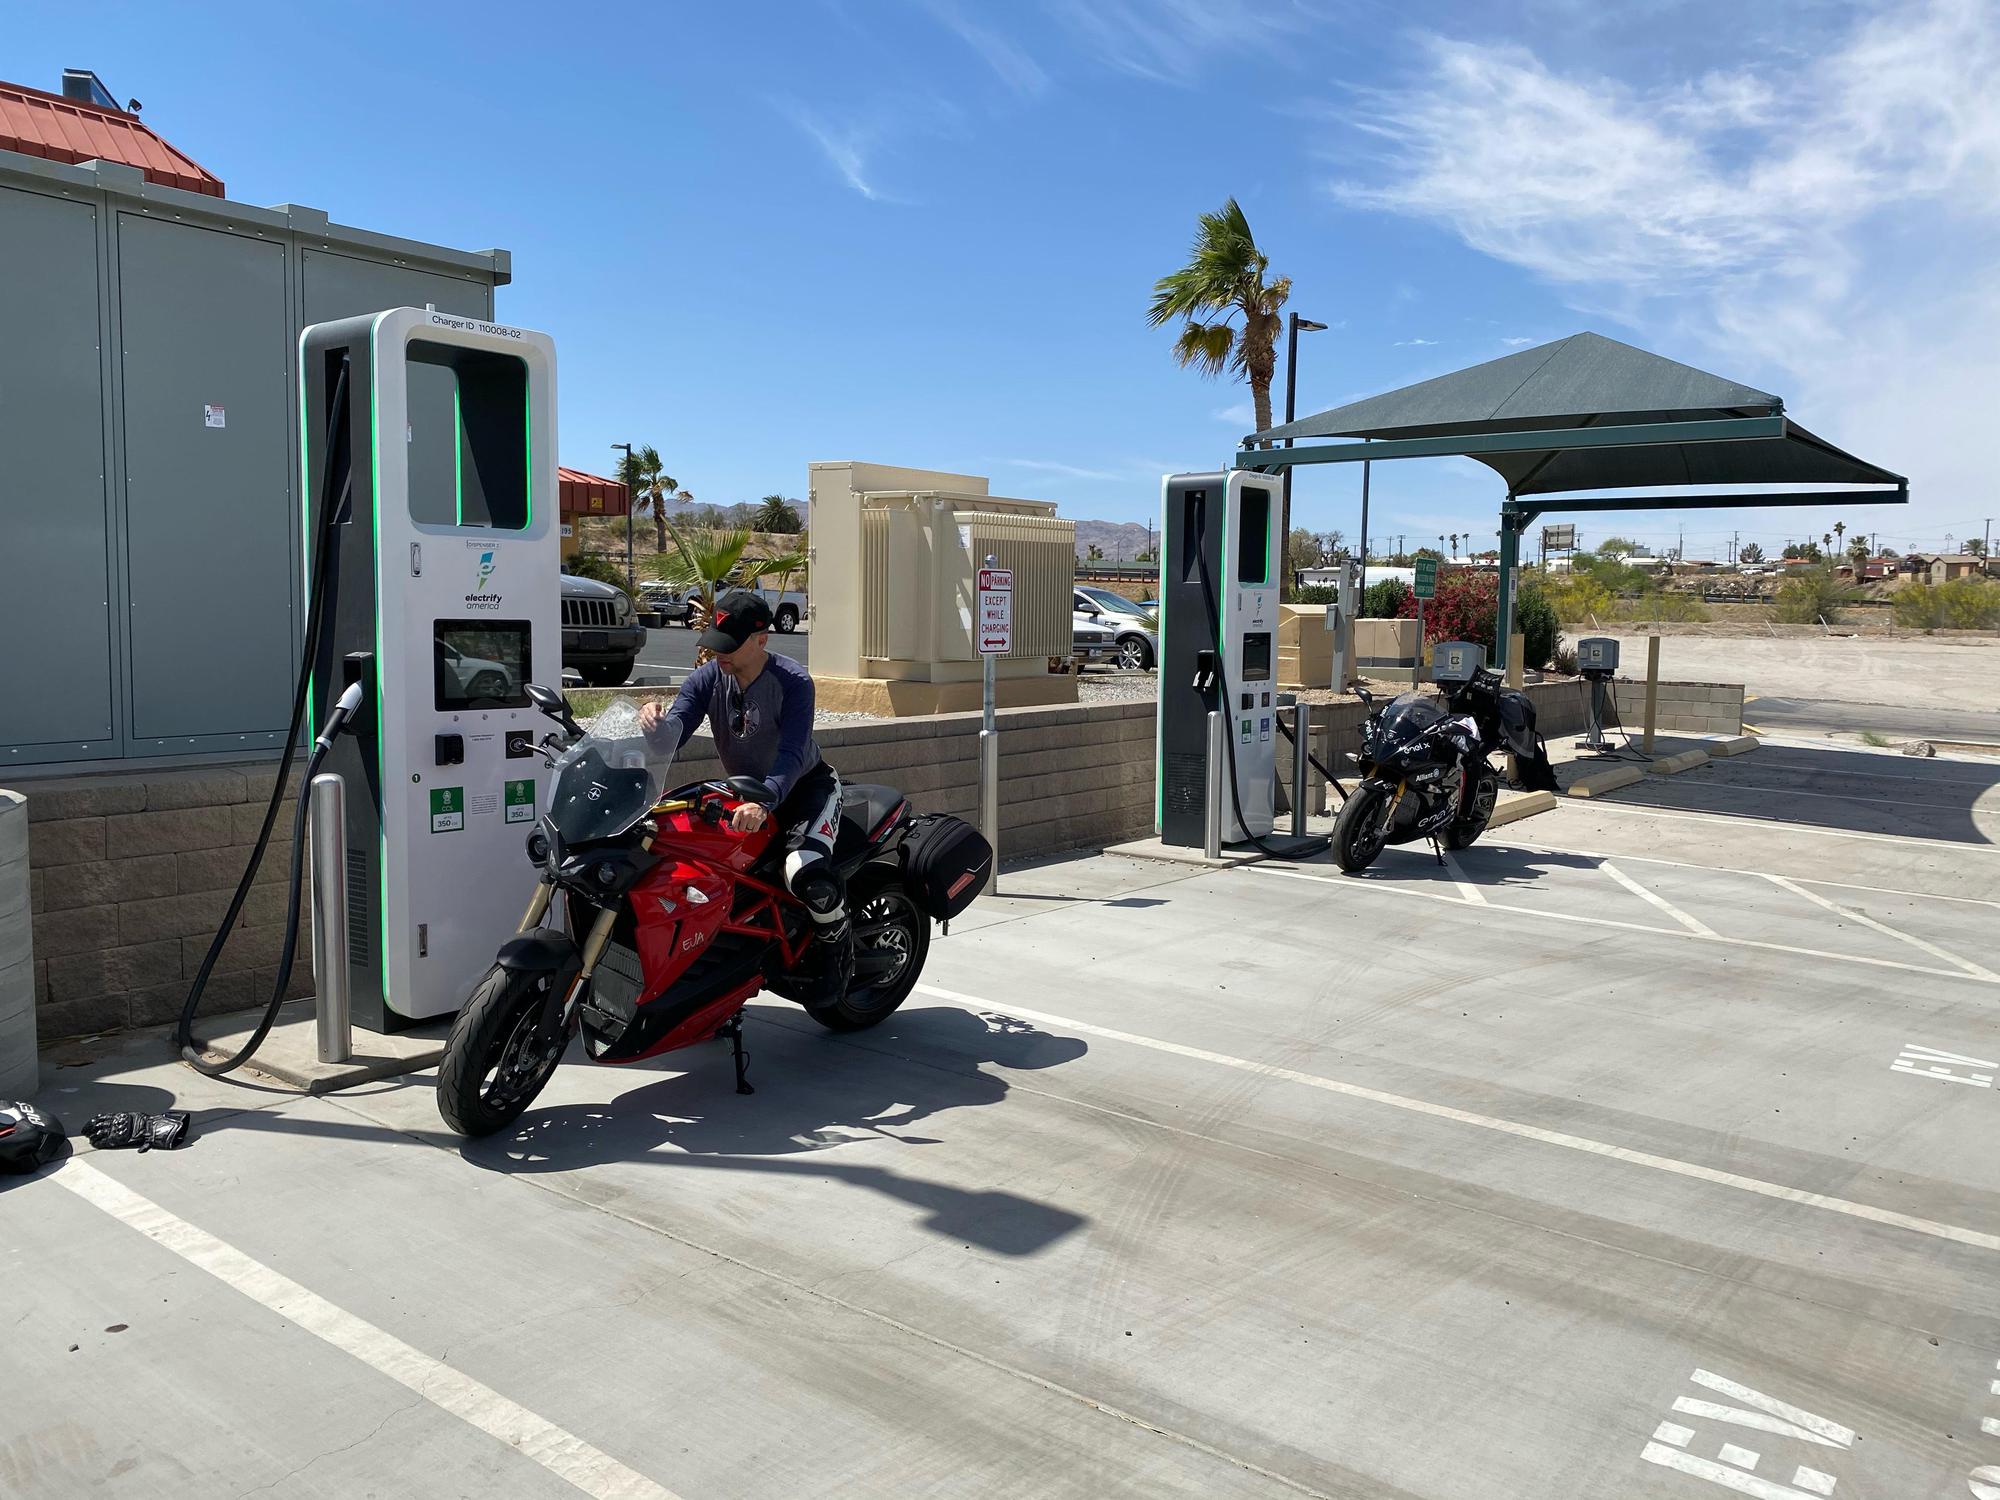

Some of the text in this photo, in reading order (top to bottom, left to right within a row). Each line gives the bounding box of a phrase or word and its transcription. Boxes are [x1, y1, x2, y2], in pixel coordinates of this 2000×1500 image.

[432, 315, 521, 339] Charger ID 110008-02
[981, 574, 1011, 588] NO PARKING
[465, 593, 502, 603] electrify
[985, 596, 1007, 606] EXCEPT
[986, 610, 1004, 620] WHILE
[981, 624, 1009, 634] CHARGING
[1403, 742, 1424, 755] enel
[511, 810, 524, 818] 350
[437, 819, 451, 828] 350
[1640, 1368, 1856, 1500] EV
